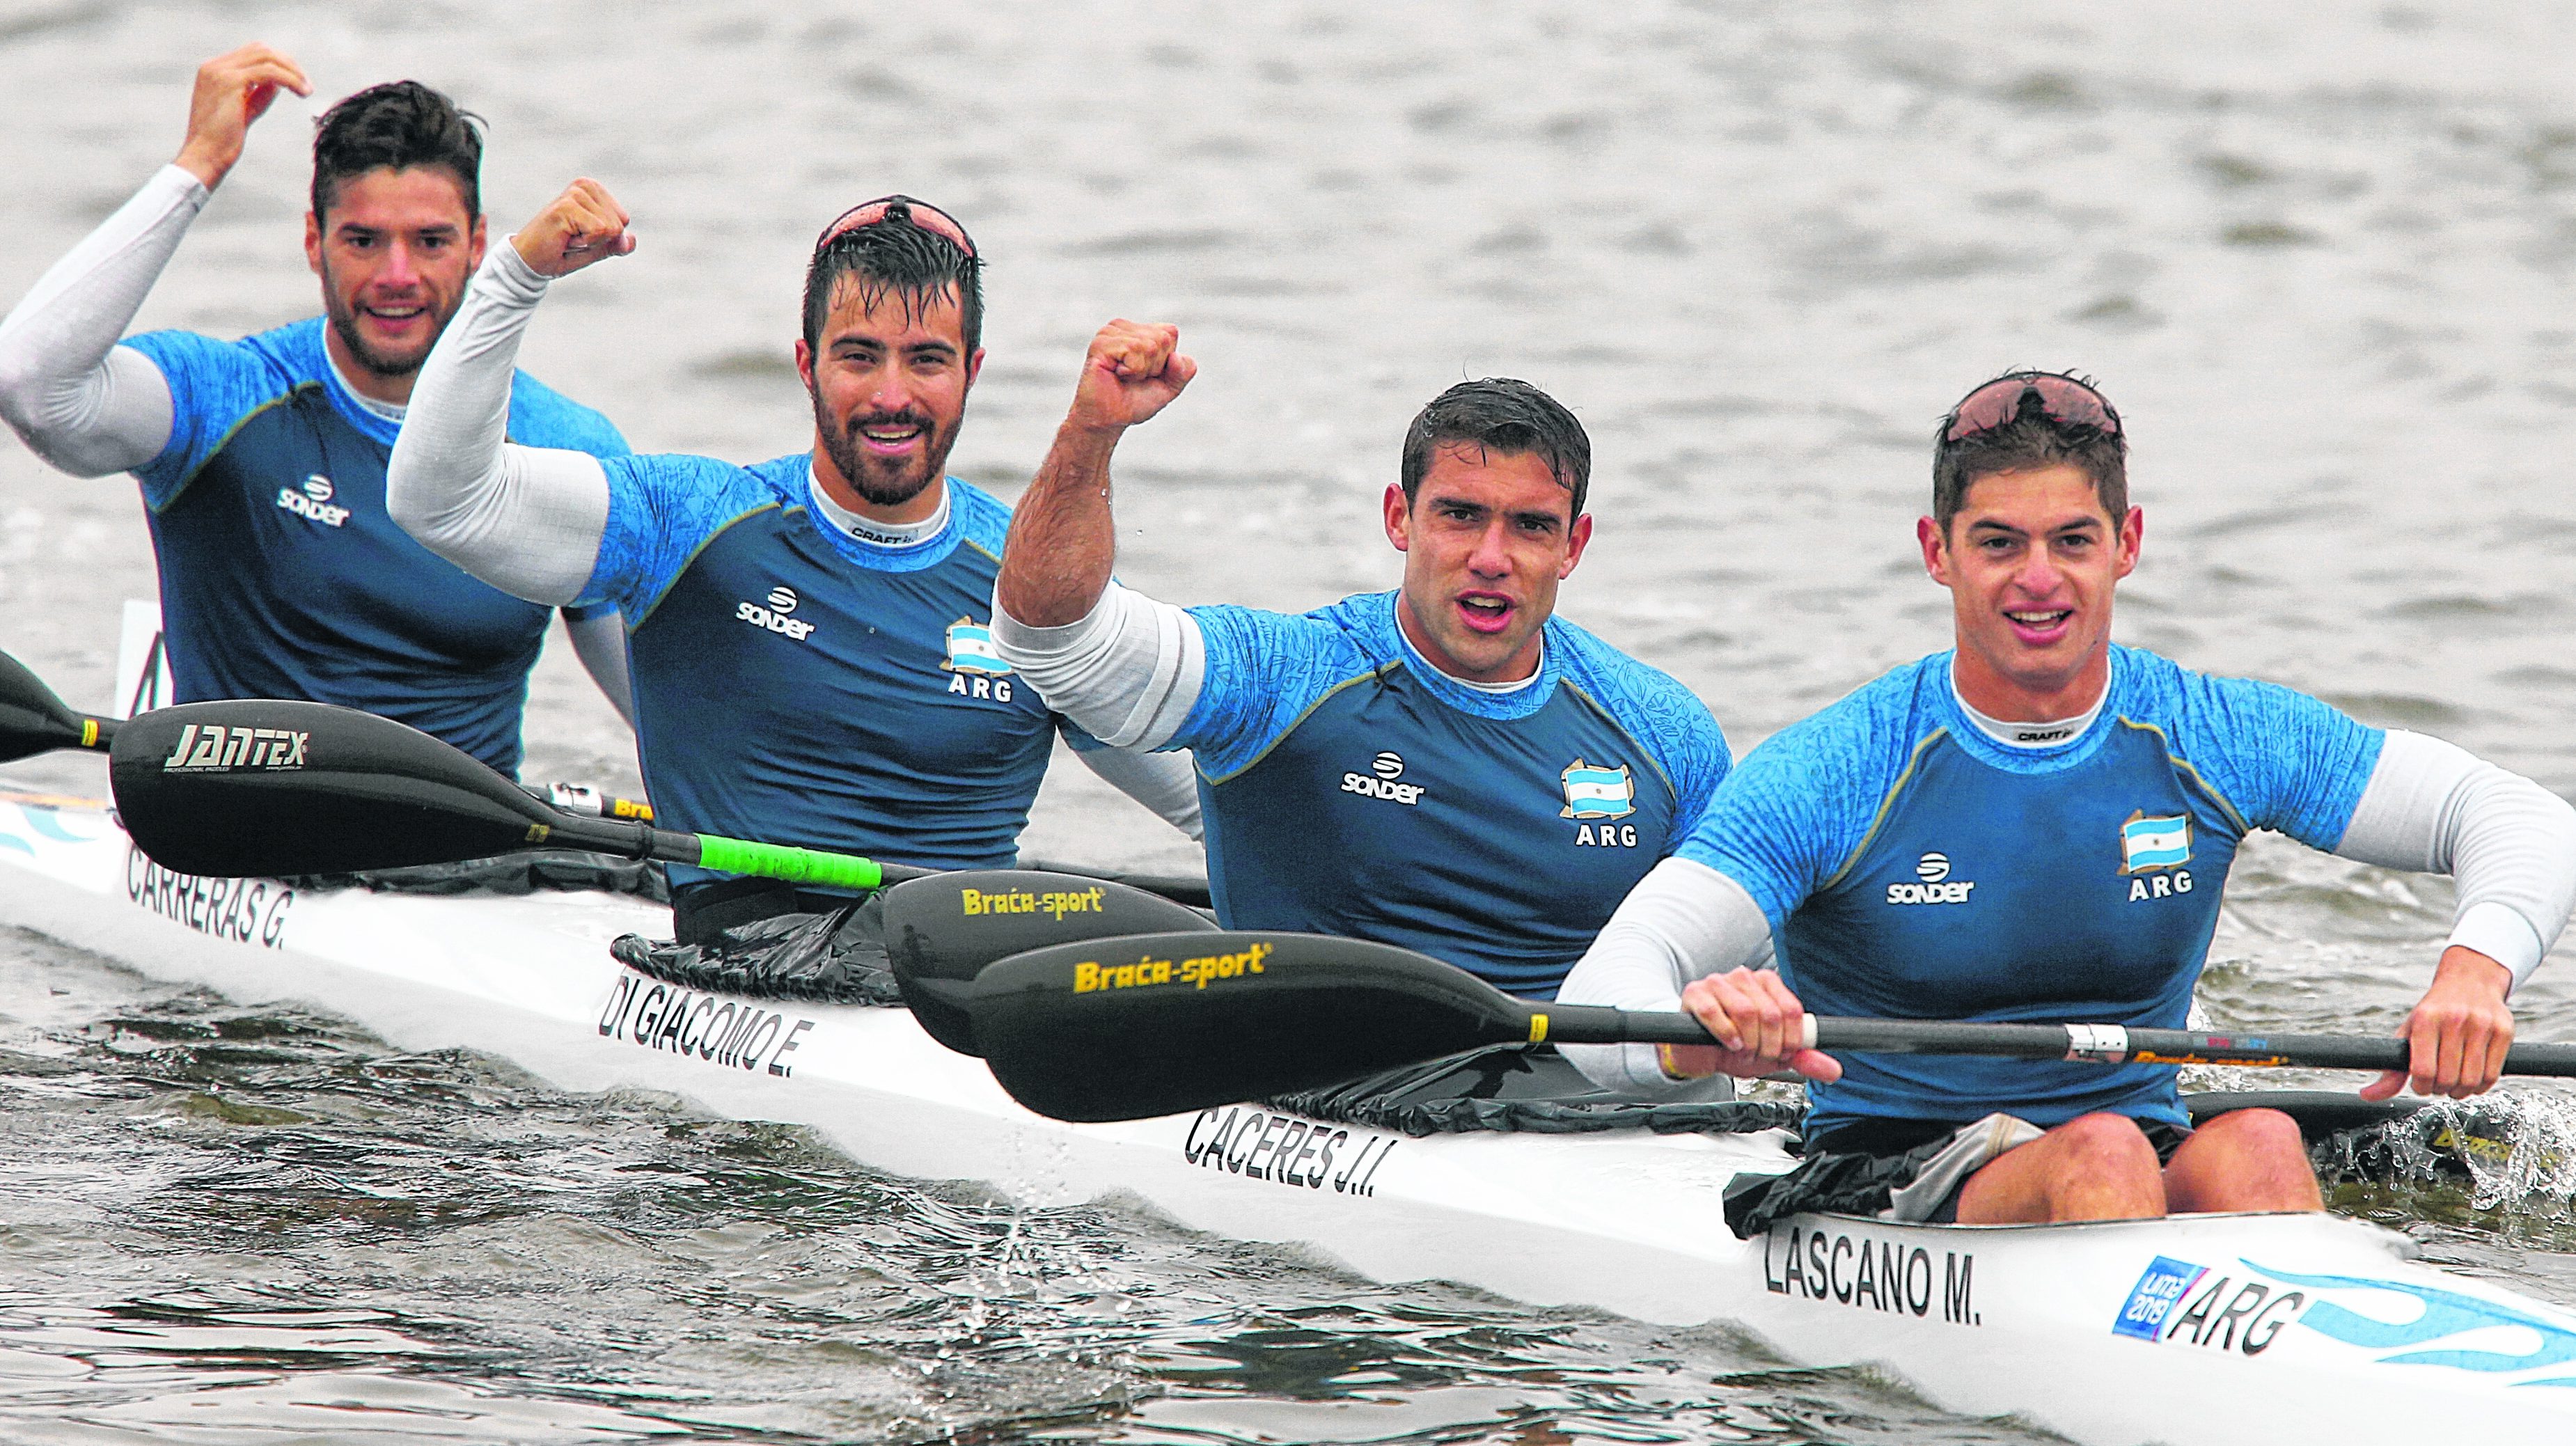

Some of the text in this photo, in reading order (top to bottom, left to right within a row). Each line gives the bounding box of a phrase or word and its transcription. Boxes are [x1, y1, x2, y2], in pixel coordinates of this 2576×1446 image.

[851, 528, 901, 544] CRAFT
[948, 674, 1012, 702] ARG
[2019, 730, 2061, 741] CRAFT
[1576, 824, 1637, 847] ARG
[127, 843, 294, 950] CARRERAS G.
[2128, 870, 2193, 902] ARG
[599, 975, 816, 1078] DI GIACOMO E.
[1185, 1108, 1348, 1189] CACERES
[1765, 1224, 1982, 1326] LASCANO M.
[2127, 1294, 2170, 1325] 2019
[2167, 1277, 2304, 1356] ARG
